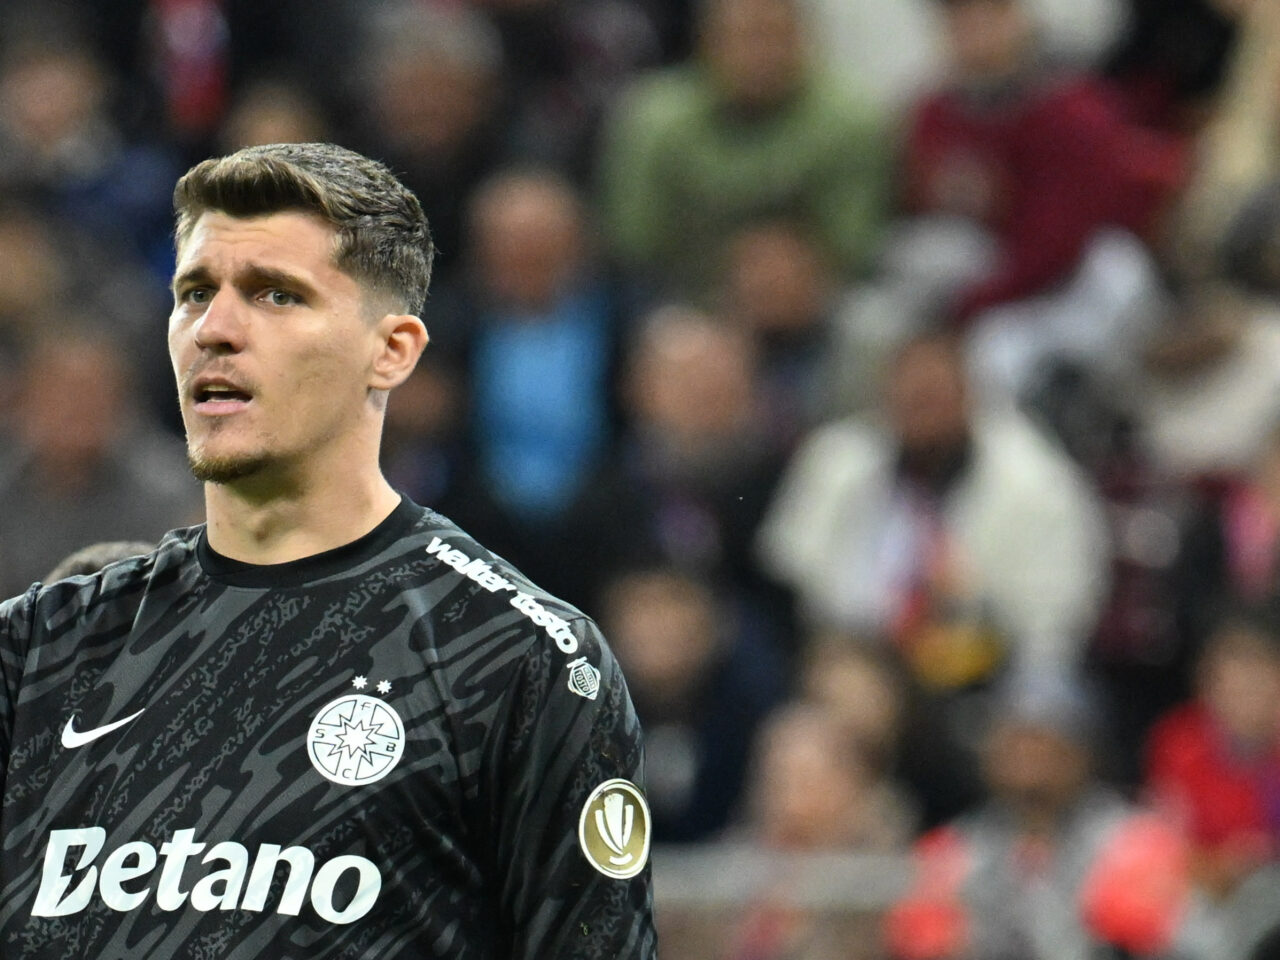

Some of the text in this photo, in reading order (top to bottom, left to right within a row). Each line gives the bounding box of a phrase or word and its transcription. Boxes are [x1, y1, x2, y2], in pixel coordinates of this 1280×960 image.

[425, 536, 578, 654] walter tosto
[31, 826, 382, 925] Betano
